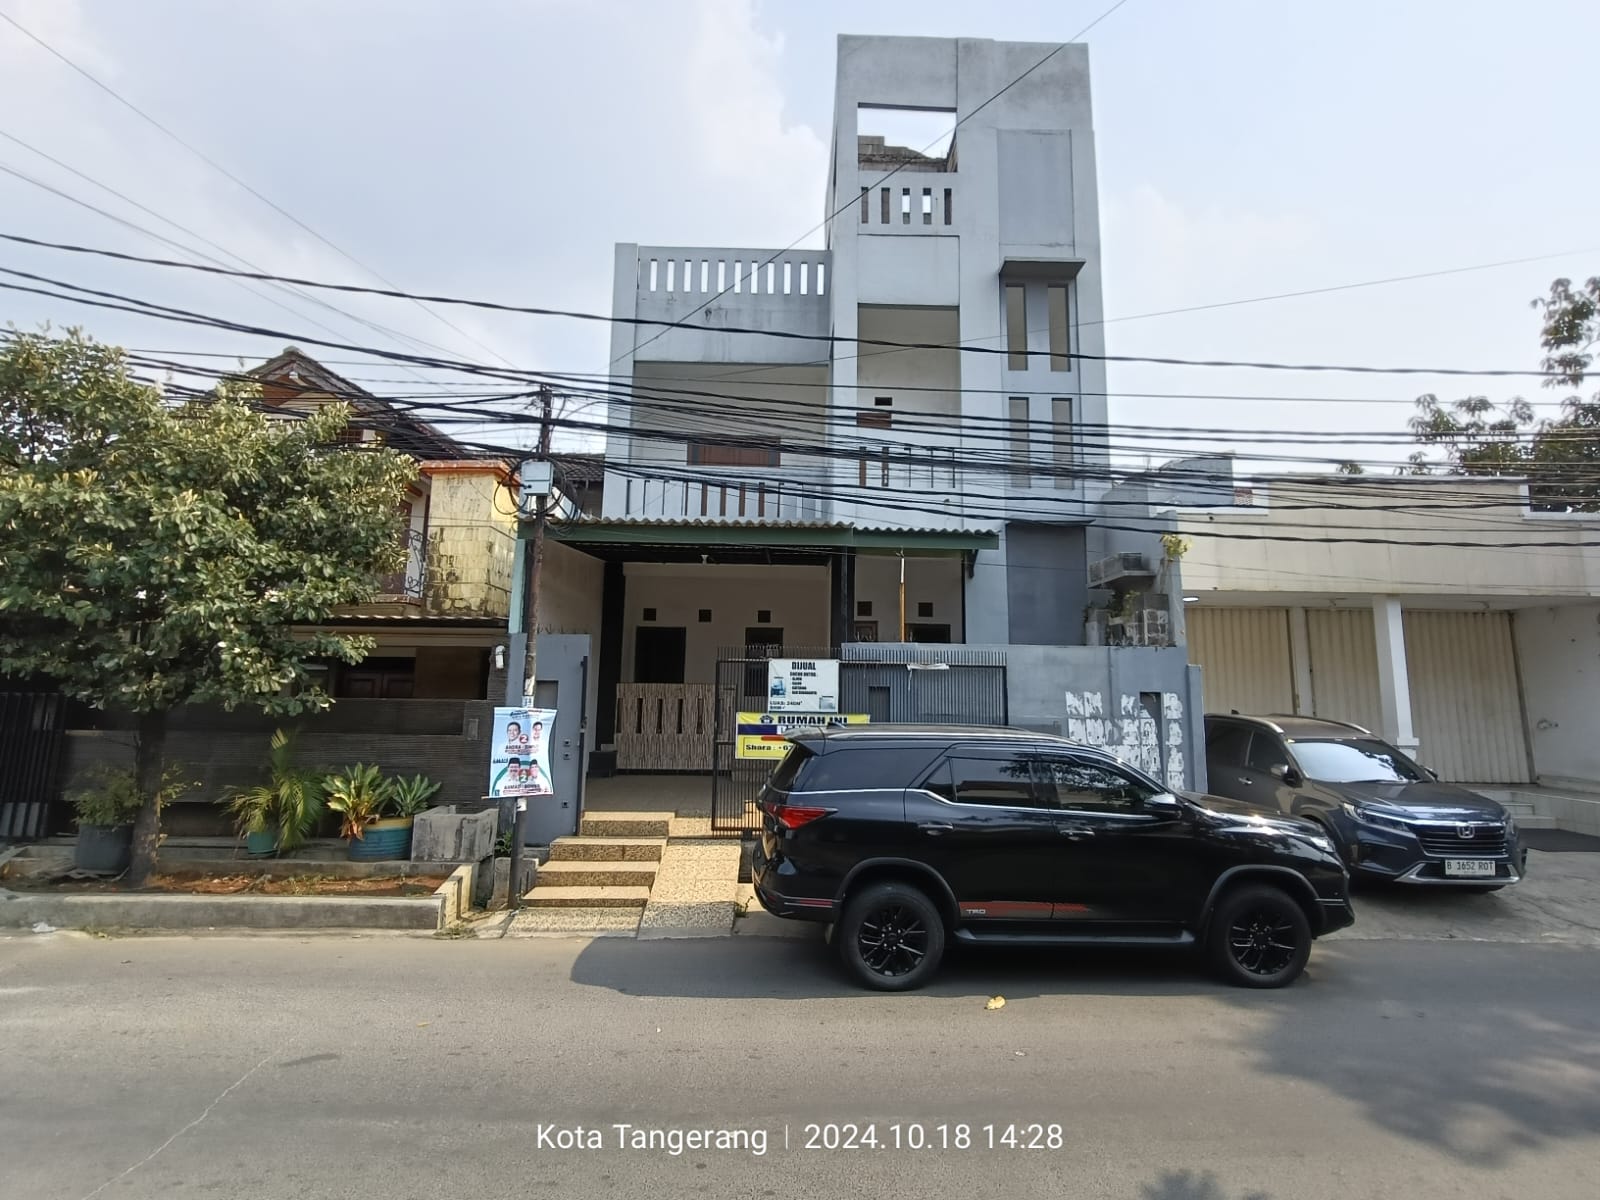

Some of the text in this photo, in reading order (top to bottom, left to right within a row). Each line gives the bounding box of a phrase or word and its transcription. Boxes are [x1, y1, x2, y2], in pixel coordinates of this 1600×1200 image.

[791, 661, 817, 671] DIJUAL
[778, 715, 848, 725] RUMAH INI
[1447, 861, 1452, 870] B
